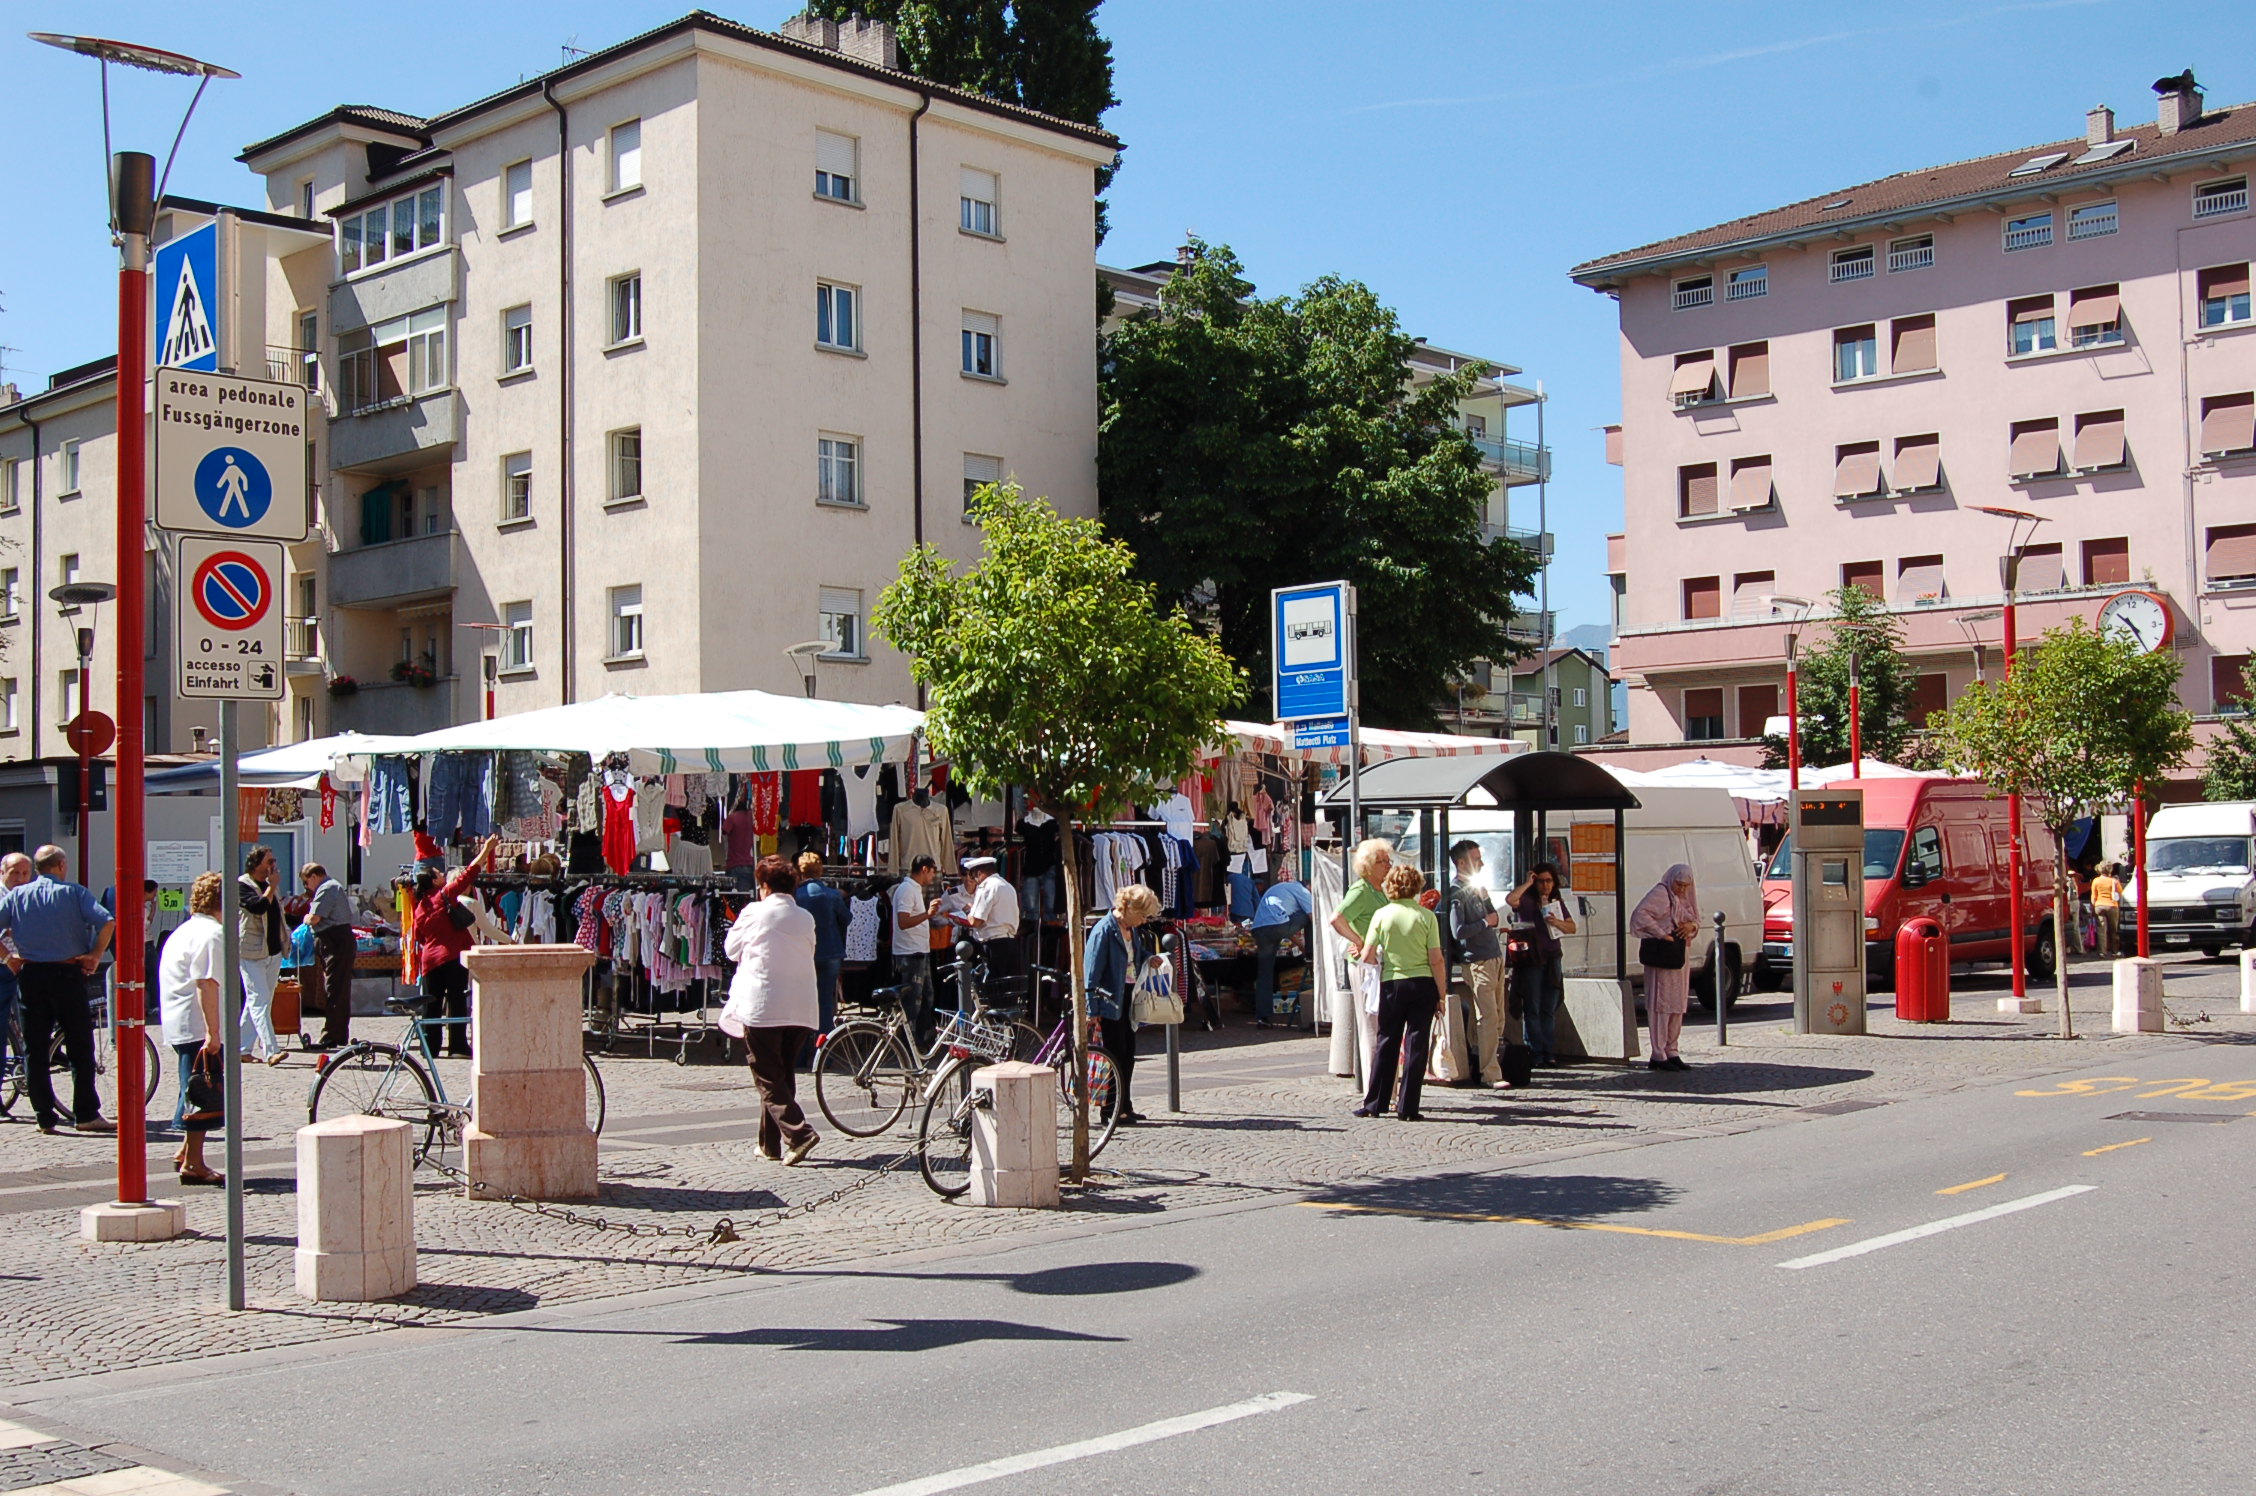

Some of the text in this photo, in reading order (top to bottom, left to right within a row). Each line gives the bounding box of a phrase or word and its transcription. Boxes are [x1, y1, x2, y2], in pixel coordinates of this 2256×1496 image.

[169, 381, 296, 408] area pedonale
[163, 404, 300, 437] Fussgängerzone
[237, 640, 263, 654] 24
[186, 661, 241, 671] accesso
[186, 676, 239, 689] Einfahrt
